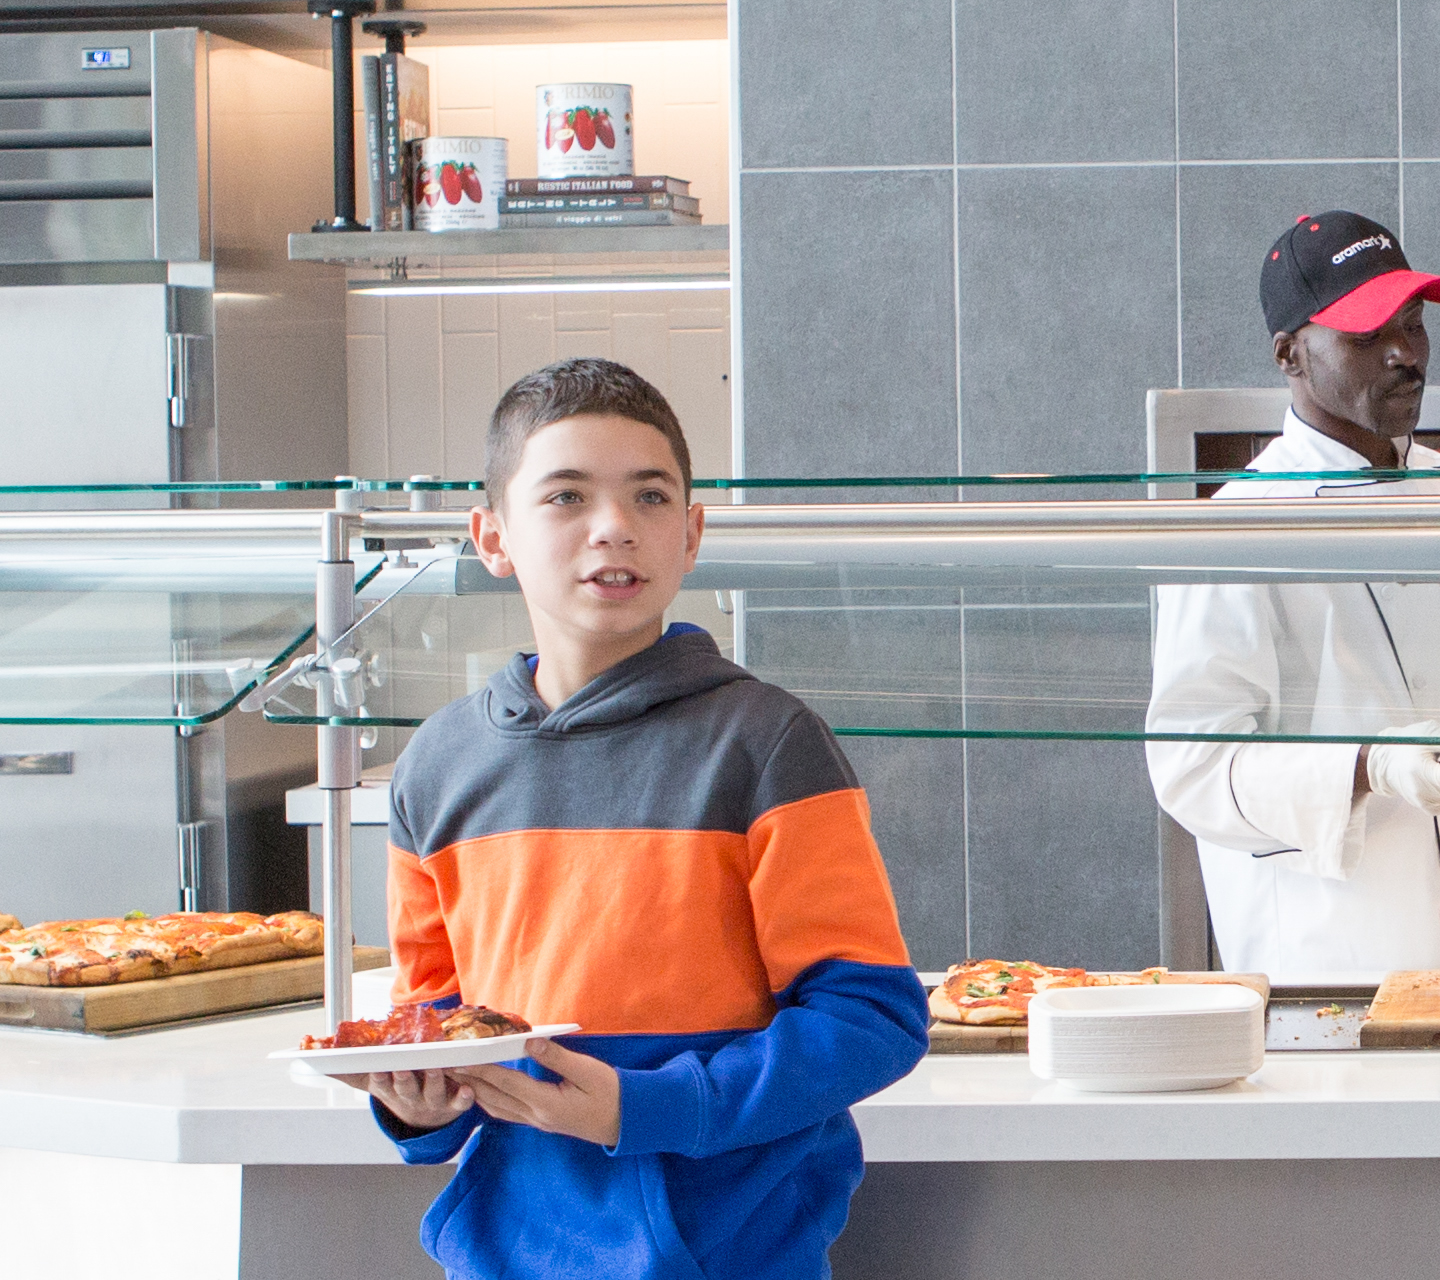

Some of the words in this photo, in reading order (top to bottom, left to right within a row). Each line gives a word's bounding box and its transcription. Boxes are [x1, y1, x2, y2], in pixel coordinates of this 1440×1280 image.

[385, 63, 395, 121] EATING
[388, 127, 396, 174] ITALY
[537, 181, 570, 192] RUSTIC
[572, 181, 608, 191] ITALIAN
[610, 180, 633, 190] FOOD
[508, 199, 564, 208] EATING
[570, 199, 616, 207] ITALY
